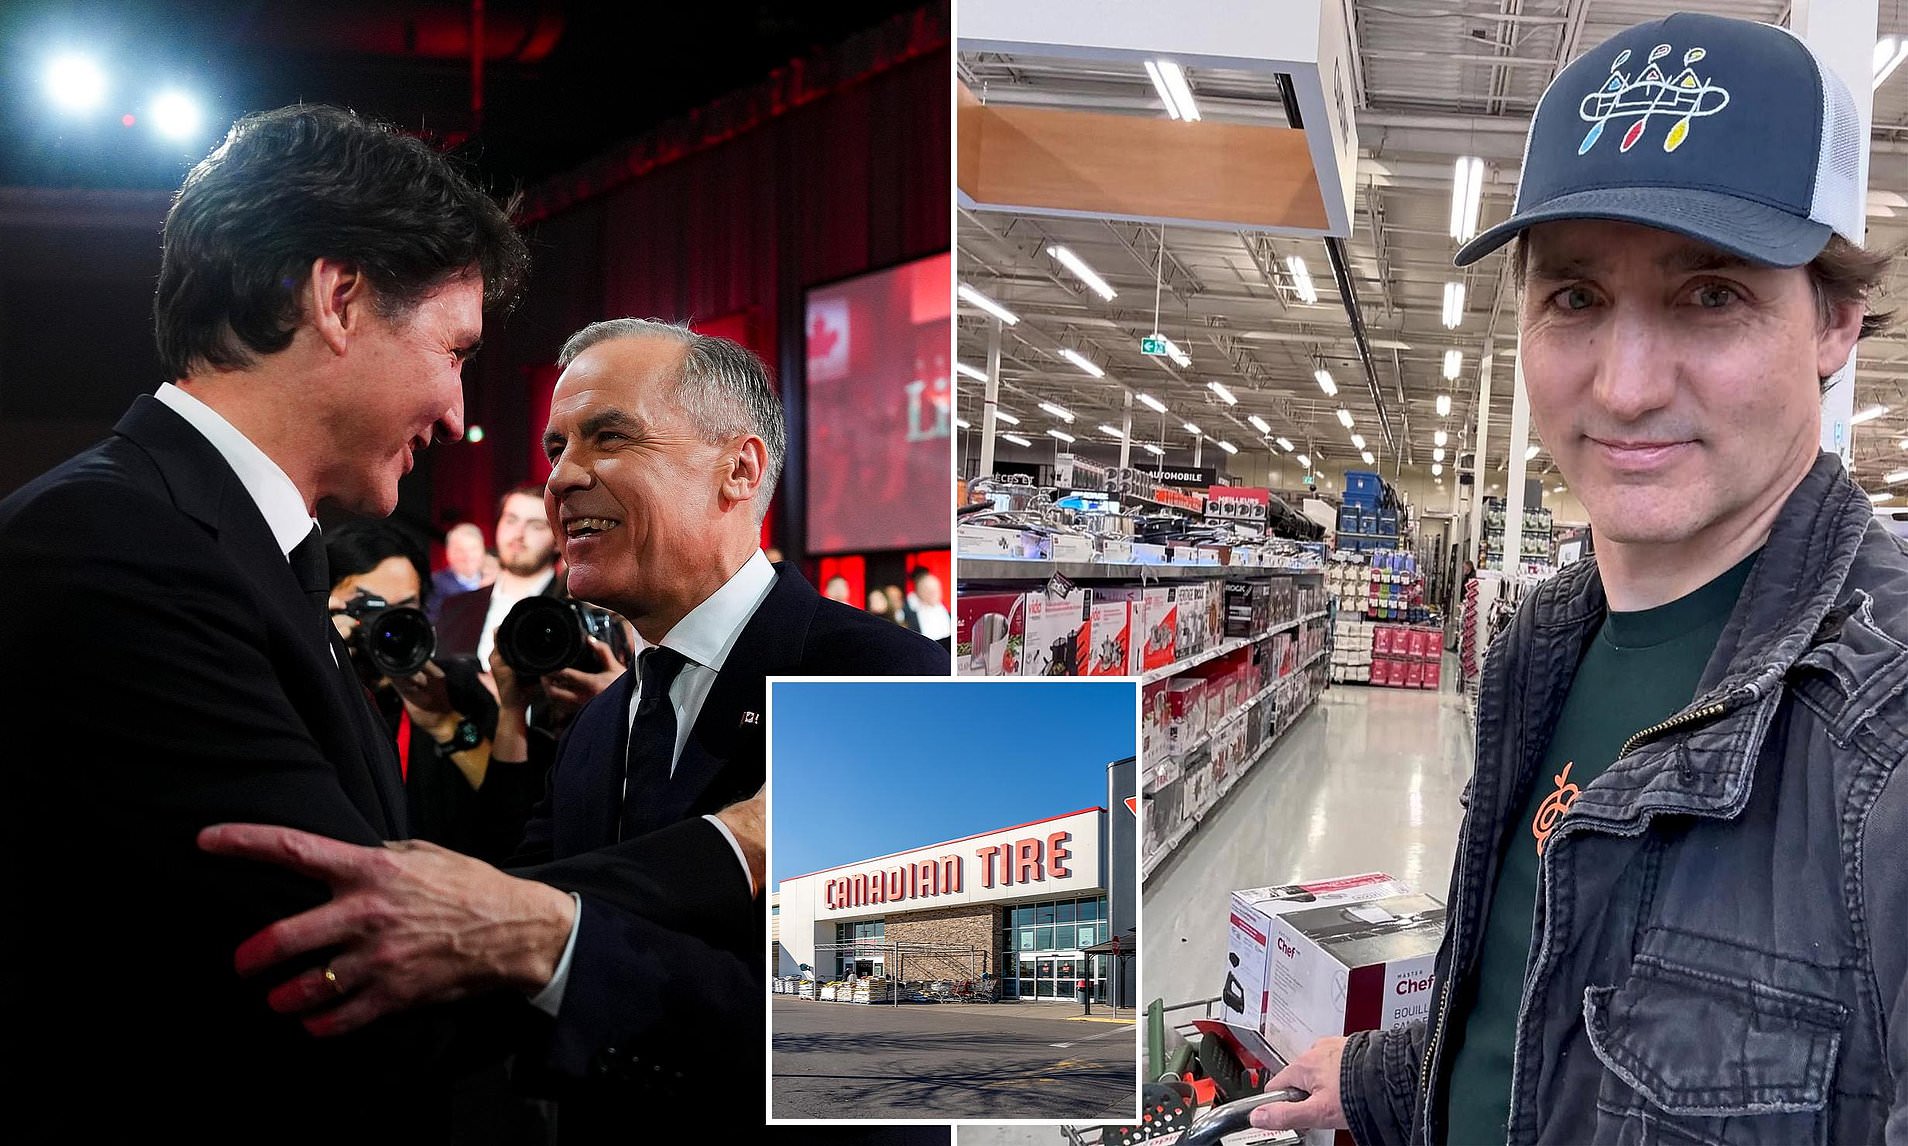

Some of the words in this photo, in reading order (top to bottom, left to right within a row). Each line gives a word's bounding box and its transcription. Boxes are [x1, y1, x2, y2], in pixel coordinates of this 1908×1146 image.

[991, 472, 1019, 484] IÈCES
[1148, 470, 1203, 482] AUTOMOBILE
[824, 853, 962, 910] CANADIAN
[976, 831, 1069, 889] TIRE
[1277, 937, 1296, 960] Chef
[1397, 970, 1423, 979] MASTER
[1396, 974, 1434, 995] Chef
[1394, 1003, 1429, 1020] BOUILL
